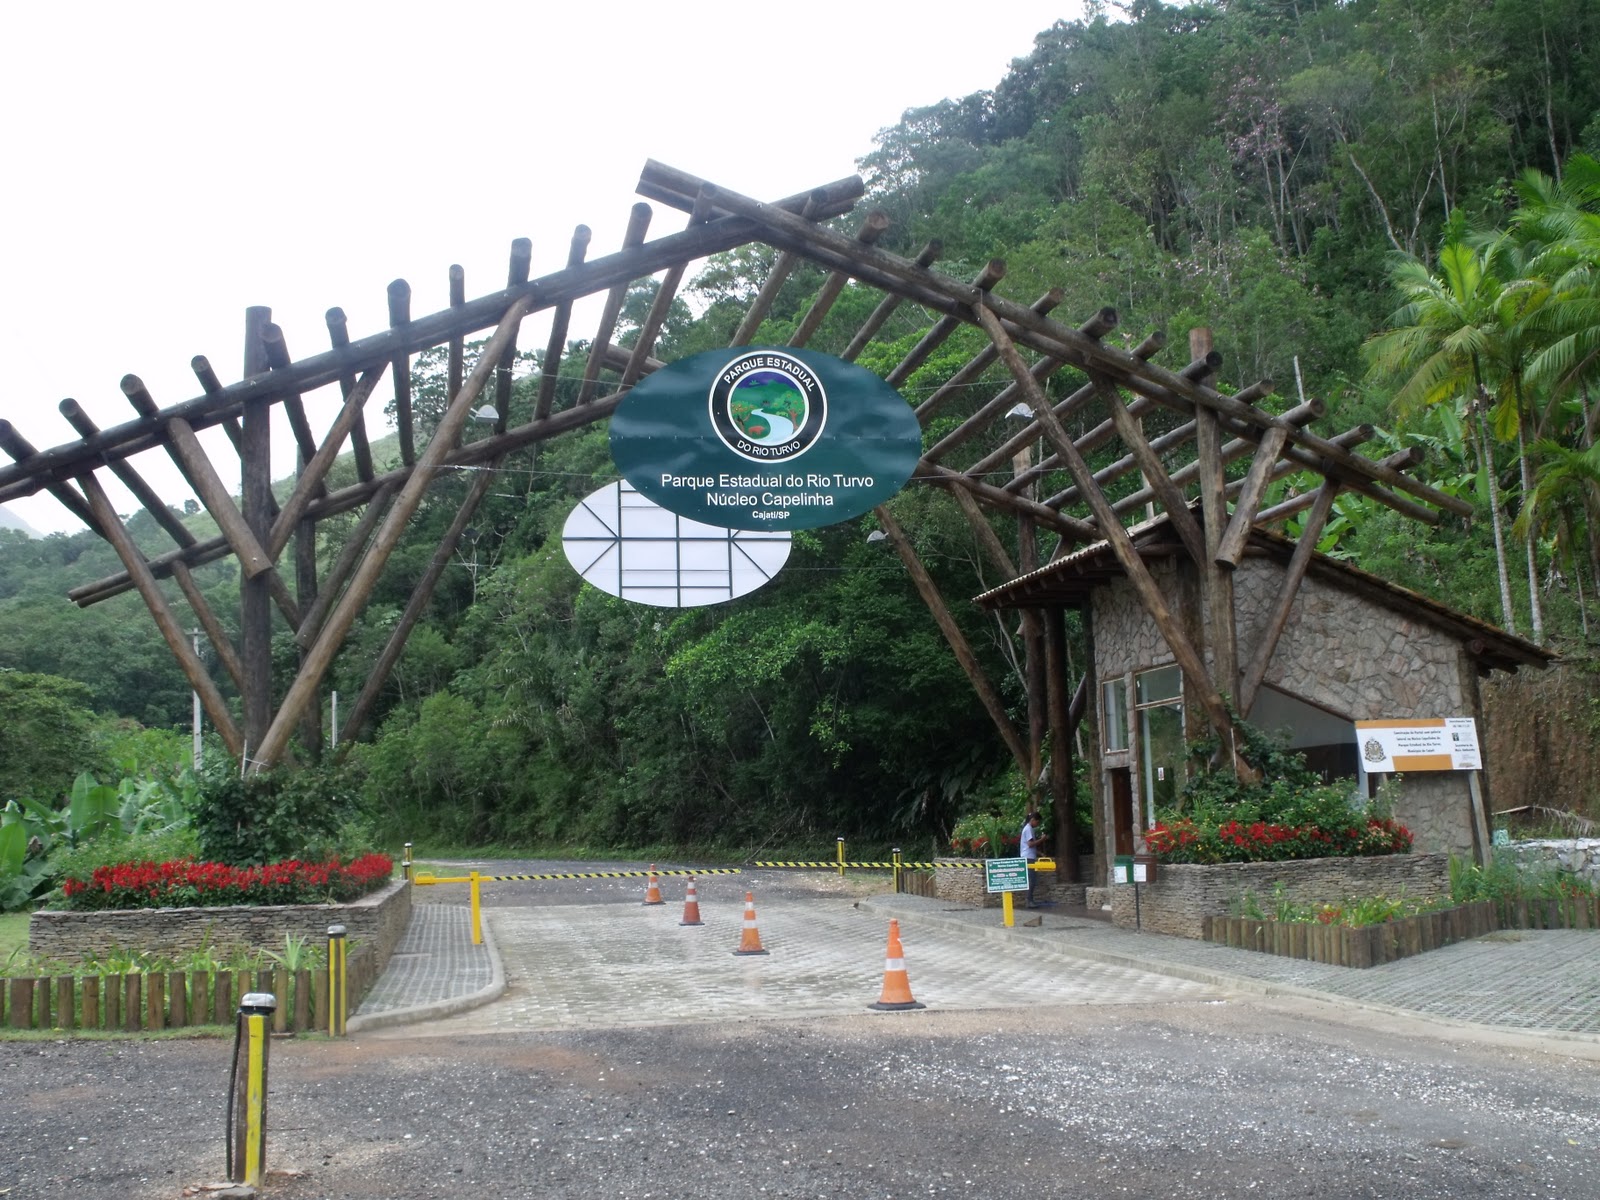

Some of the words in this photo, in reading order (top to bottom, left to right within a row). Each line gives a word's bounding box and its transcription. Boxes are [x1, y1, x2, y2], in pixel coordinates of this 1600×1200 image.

[723, 357, 764, 384] PARQUE
[767, 357, 815, 392] ESTADUAL
[737, 439, 752, 452] DO
[752, 447, 769, 456] RIO
[770, 440, 801, 456] TURVO
[661, 473, 715, 491] Parque
[719, 473, 782, 488] Estadual
[785, 473, 804, 488] do
[807, 473, 831, 488] Rio
[833, 473, 874, 488] Turvo
[707, 491, 758, 506] Núcleo
[761, 491, 834, 508] Capelinha
[752, 510, 790, 520] Cajati/SP
